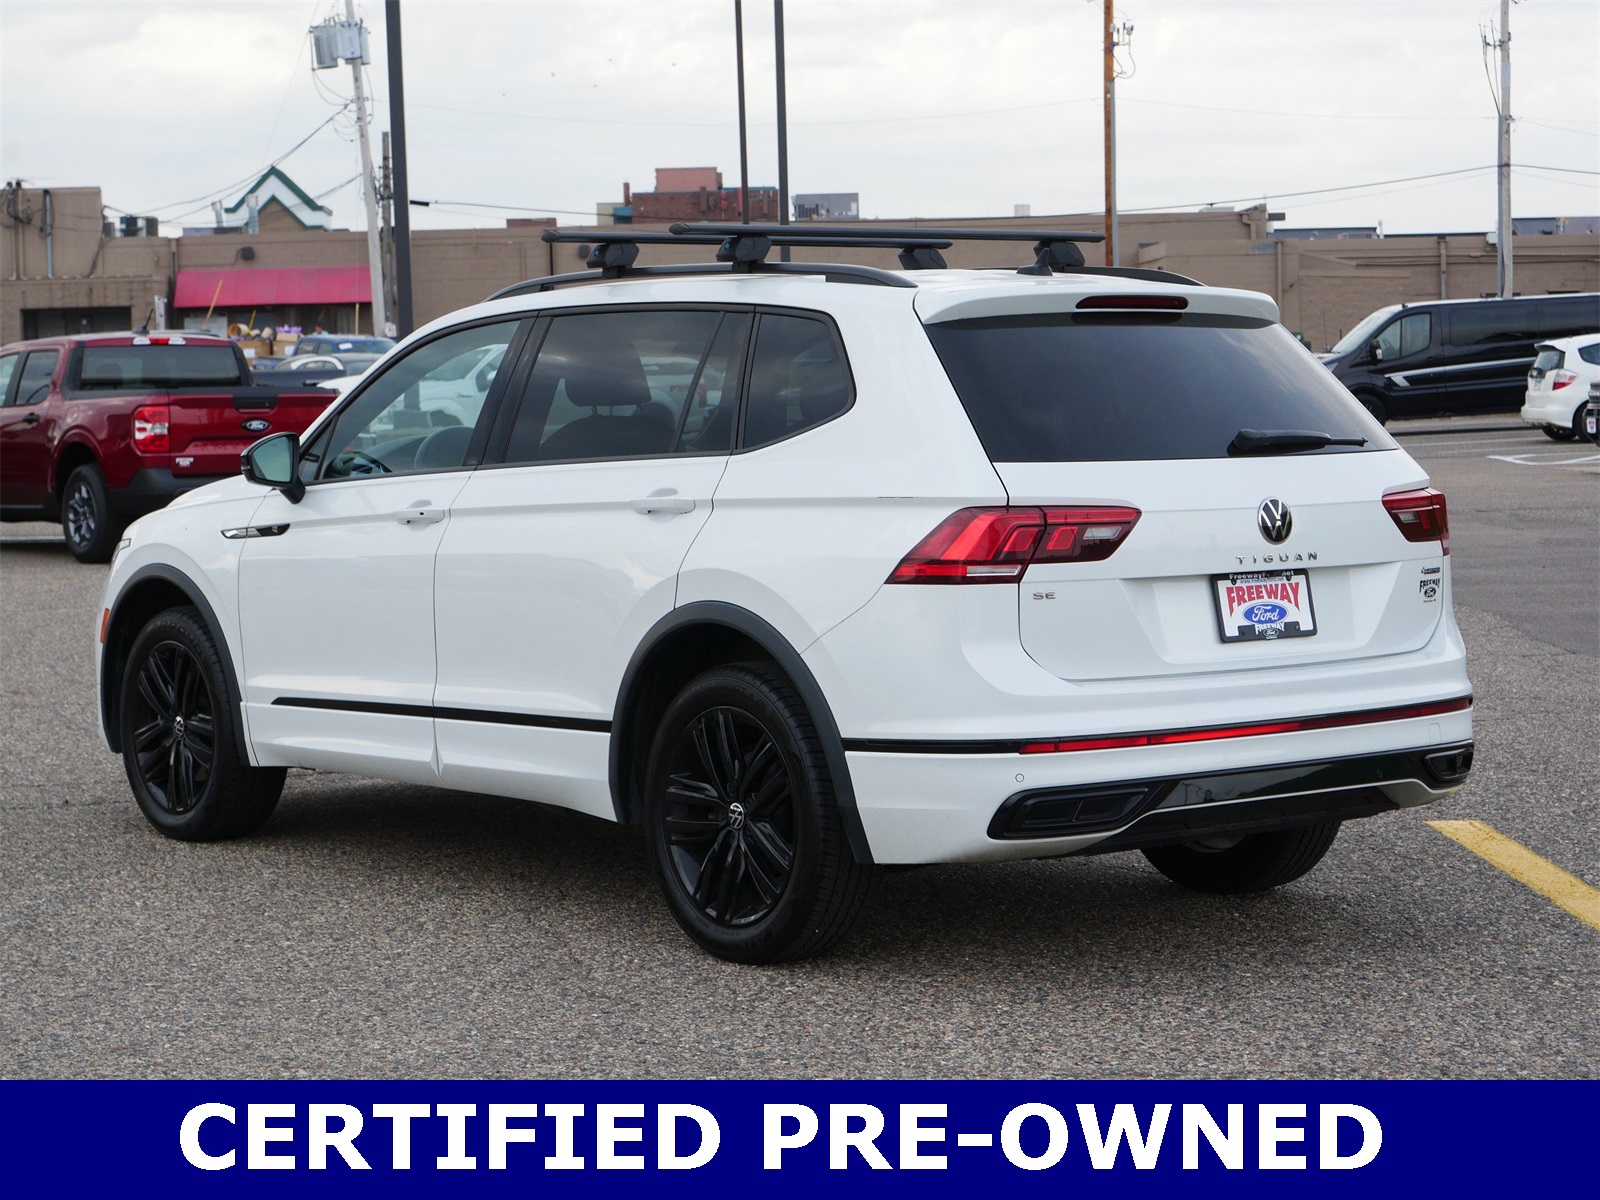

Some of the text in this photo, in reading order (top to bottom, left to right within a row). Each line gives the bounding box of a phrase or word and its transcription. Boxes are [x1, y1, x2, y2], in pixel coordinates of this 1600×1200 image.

[1236, 551, 1318, 565] TIGUAN
[1033, 591, 1056, 600] SE
[1226, 582, 1300, 617] FREEWAY
[1251, 605, 1280, 621] Ford
